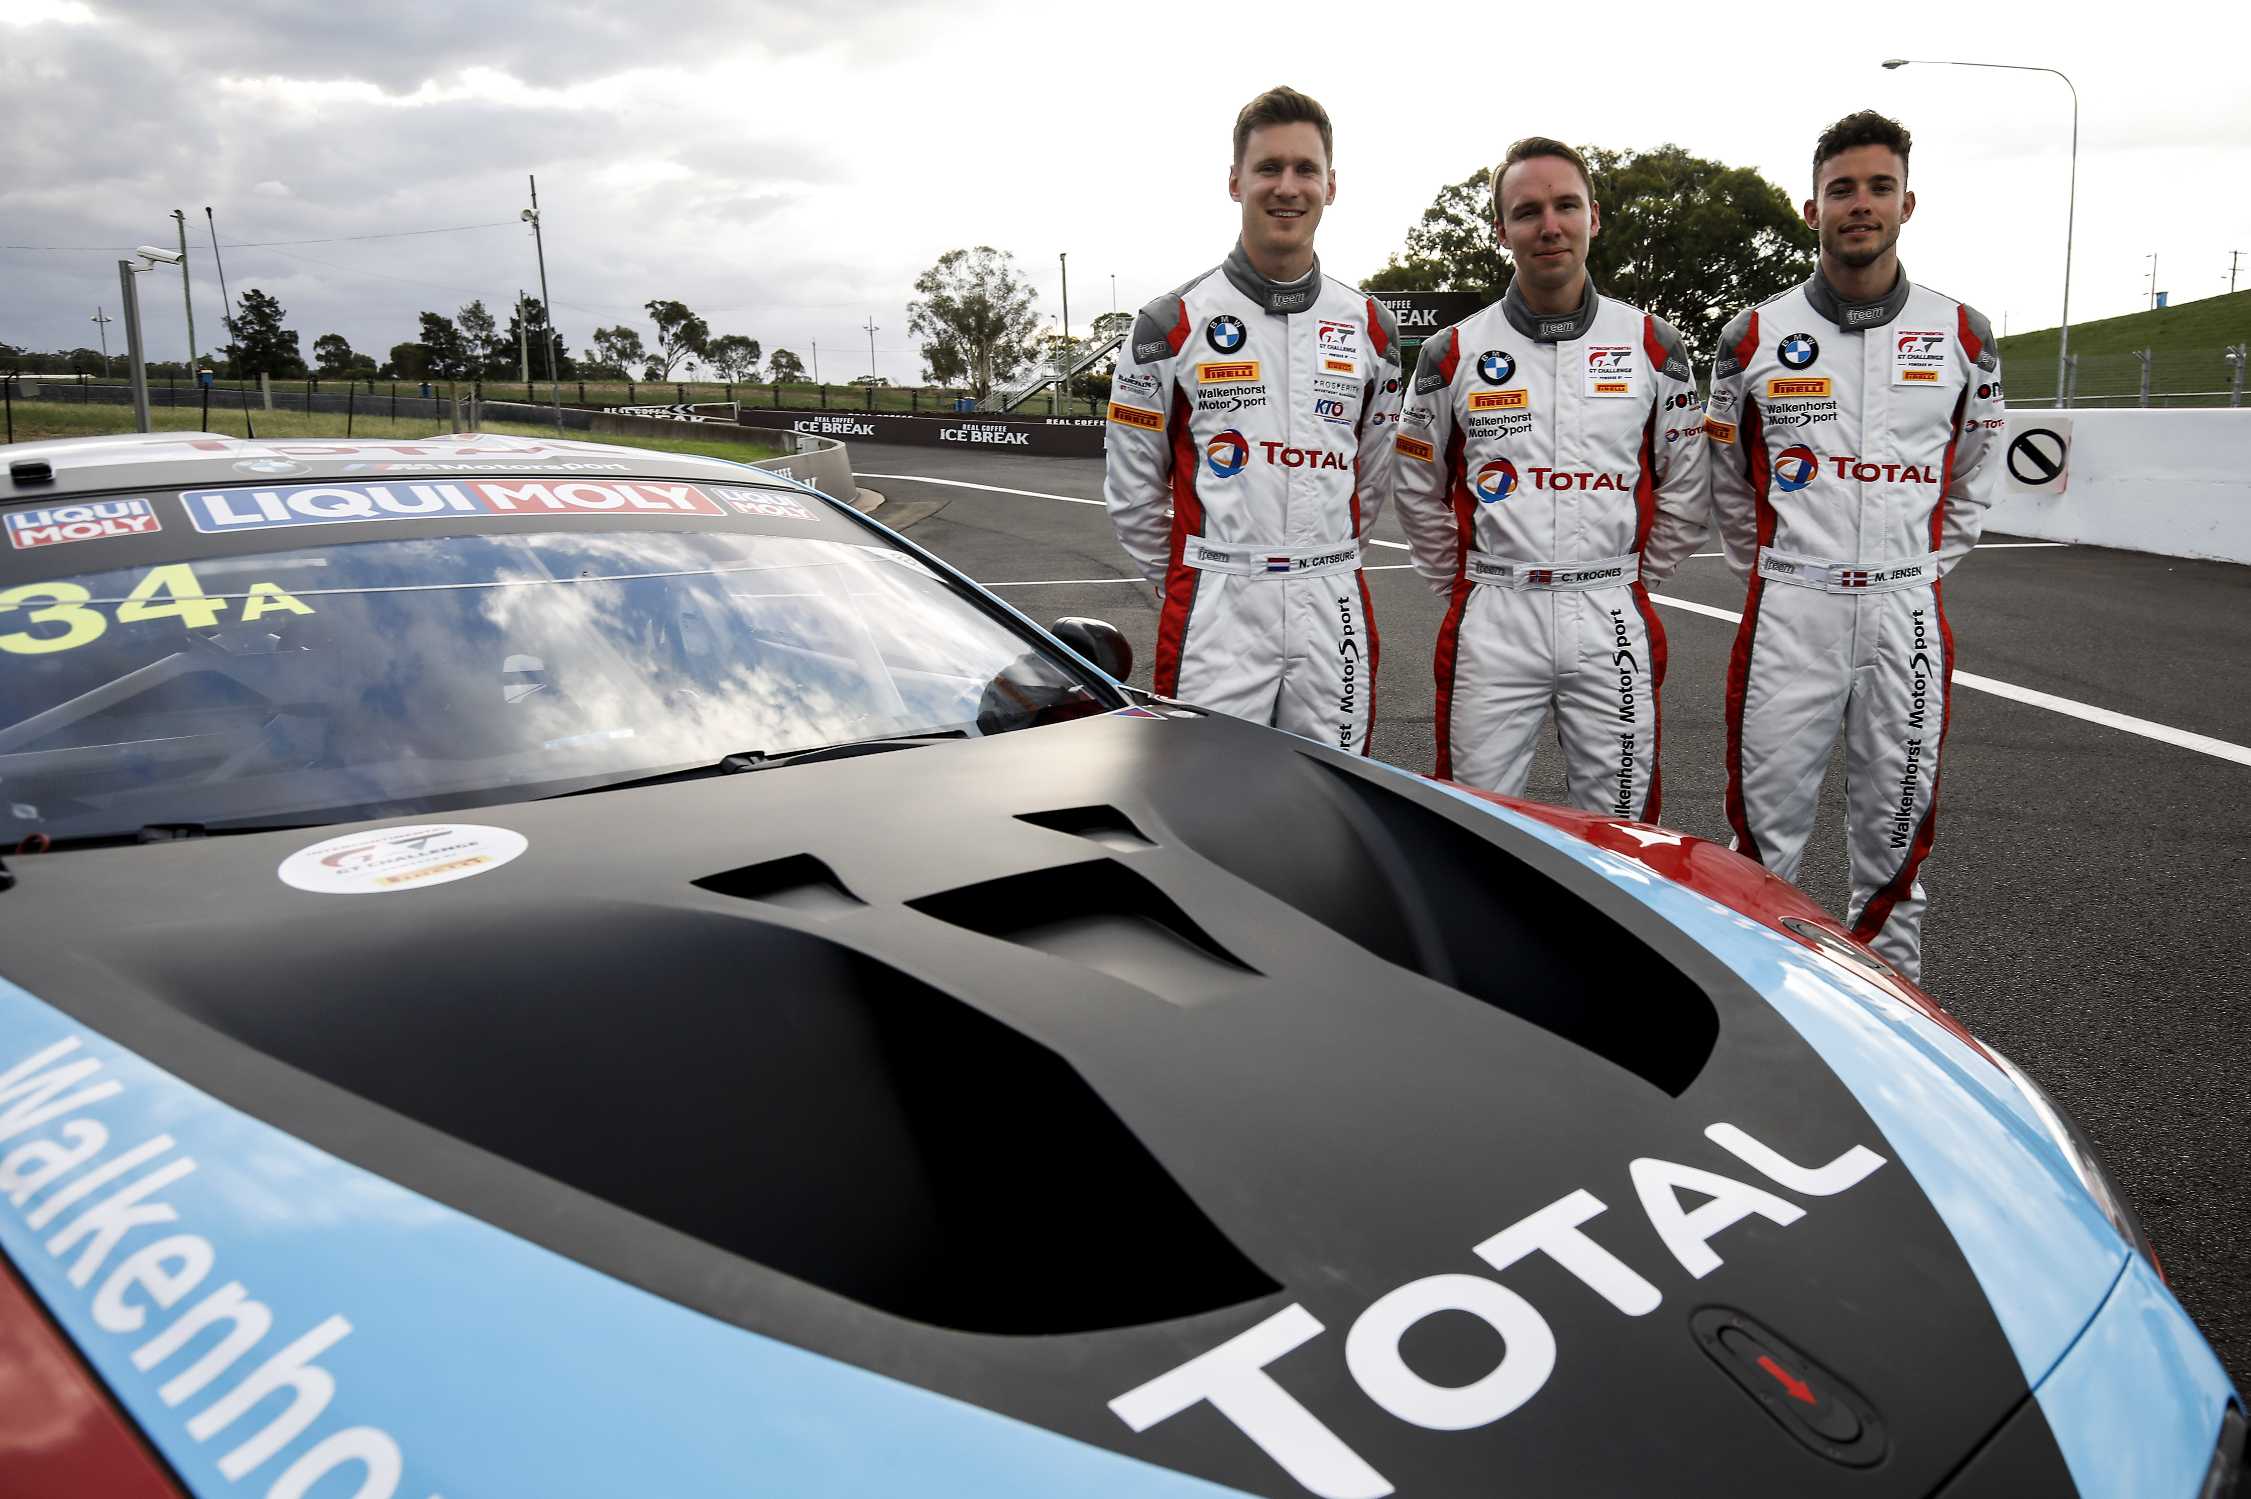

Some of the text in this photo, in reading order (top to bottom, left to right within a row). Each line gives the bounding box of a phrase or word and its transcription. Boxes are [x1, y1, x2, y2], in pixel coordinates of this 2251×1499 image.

[1396, 309, 1438, 326] EAK
[1204, 365, 1253, 379] PIRELLI
[1197, 384, 1266, 399] Walkenhorst
[1313, 379, 1360, 393] PROSPERITY
[1774, 381, 1824, 394] PIRELLI
[1198, 396, 1266, 413] MotorSport
[1475, 393, 1522, 407] PIRELLI
[1767, 400, 1837, 414] Walkenhorst
[793, 420, 876, 435] ICE BREAK
[962, 423, 1007, 432] REAL COFFEE
[1468, 412, 1532, 427] Walkenhorst
[1768, 412, 1838, 428] MotorSport
[939, 428, 1030, 445] ICE BREAK
[1469, 424, 1532, 441] MotorSport
[1260, 441, 1348, 471] TOTAL
[438, 462, 632, 473] Motorsport
[1830, 456, 1938, 484] TOTAL
[1527, 467, 1632, 491] TOTAL
[201, 483, 697, 526] LIQUI MOLY
[13, 500, 148, 529] LIQUI
[19, 515, 151, 546] MOLY
[1299, 550, 1355, 569] N. CATSBURG
[1561, 567, 1622, 582] C. KROGNES
[1874, 566, 1922, 582] M. JENSEN
[1338, 596, 1360, 713] MotorSport
[1610, 608, 1639, 819] lkenhorst MotorSport
[1890, 609, 1933, 849] Walkenhorst MotorSport
[0, 1035, 404, 1499] Walkenho
[1107, 1122, 1887, 1499] TOTAL
